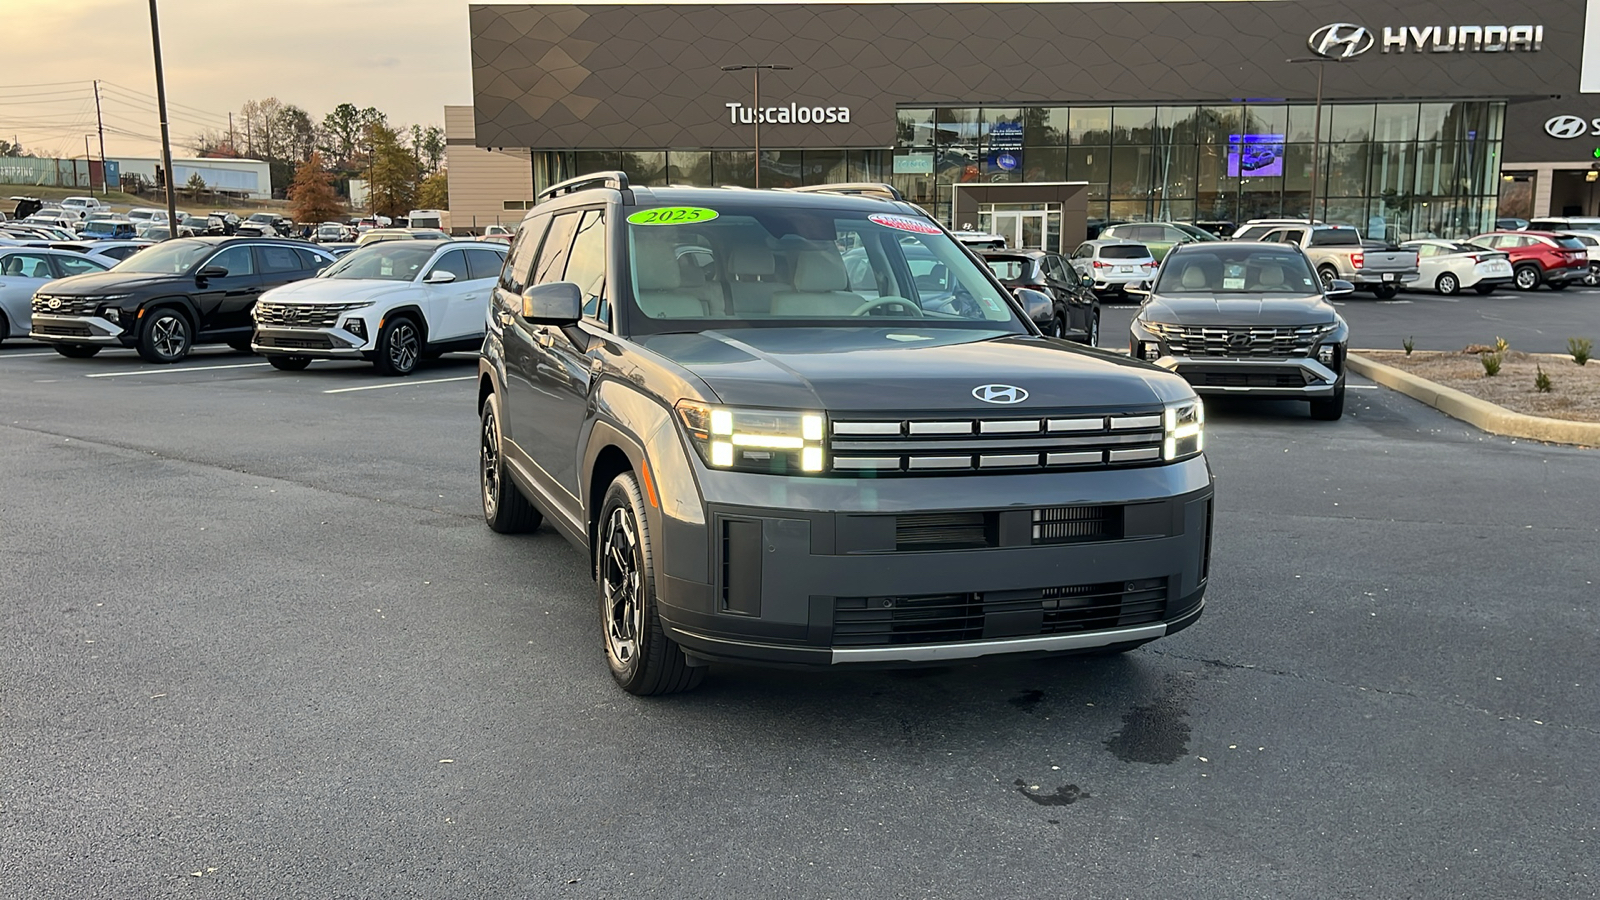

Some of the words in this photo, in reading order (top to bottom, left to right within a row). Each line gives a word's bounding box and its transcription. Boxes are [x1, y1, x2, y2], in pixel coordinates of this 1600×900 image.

[1382, 25, 1543, 52] HYUNDAI
[726, 102, 850, 124] Tuscaloosa
[643, 209, 703, 223] 2025
